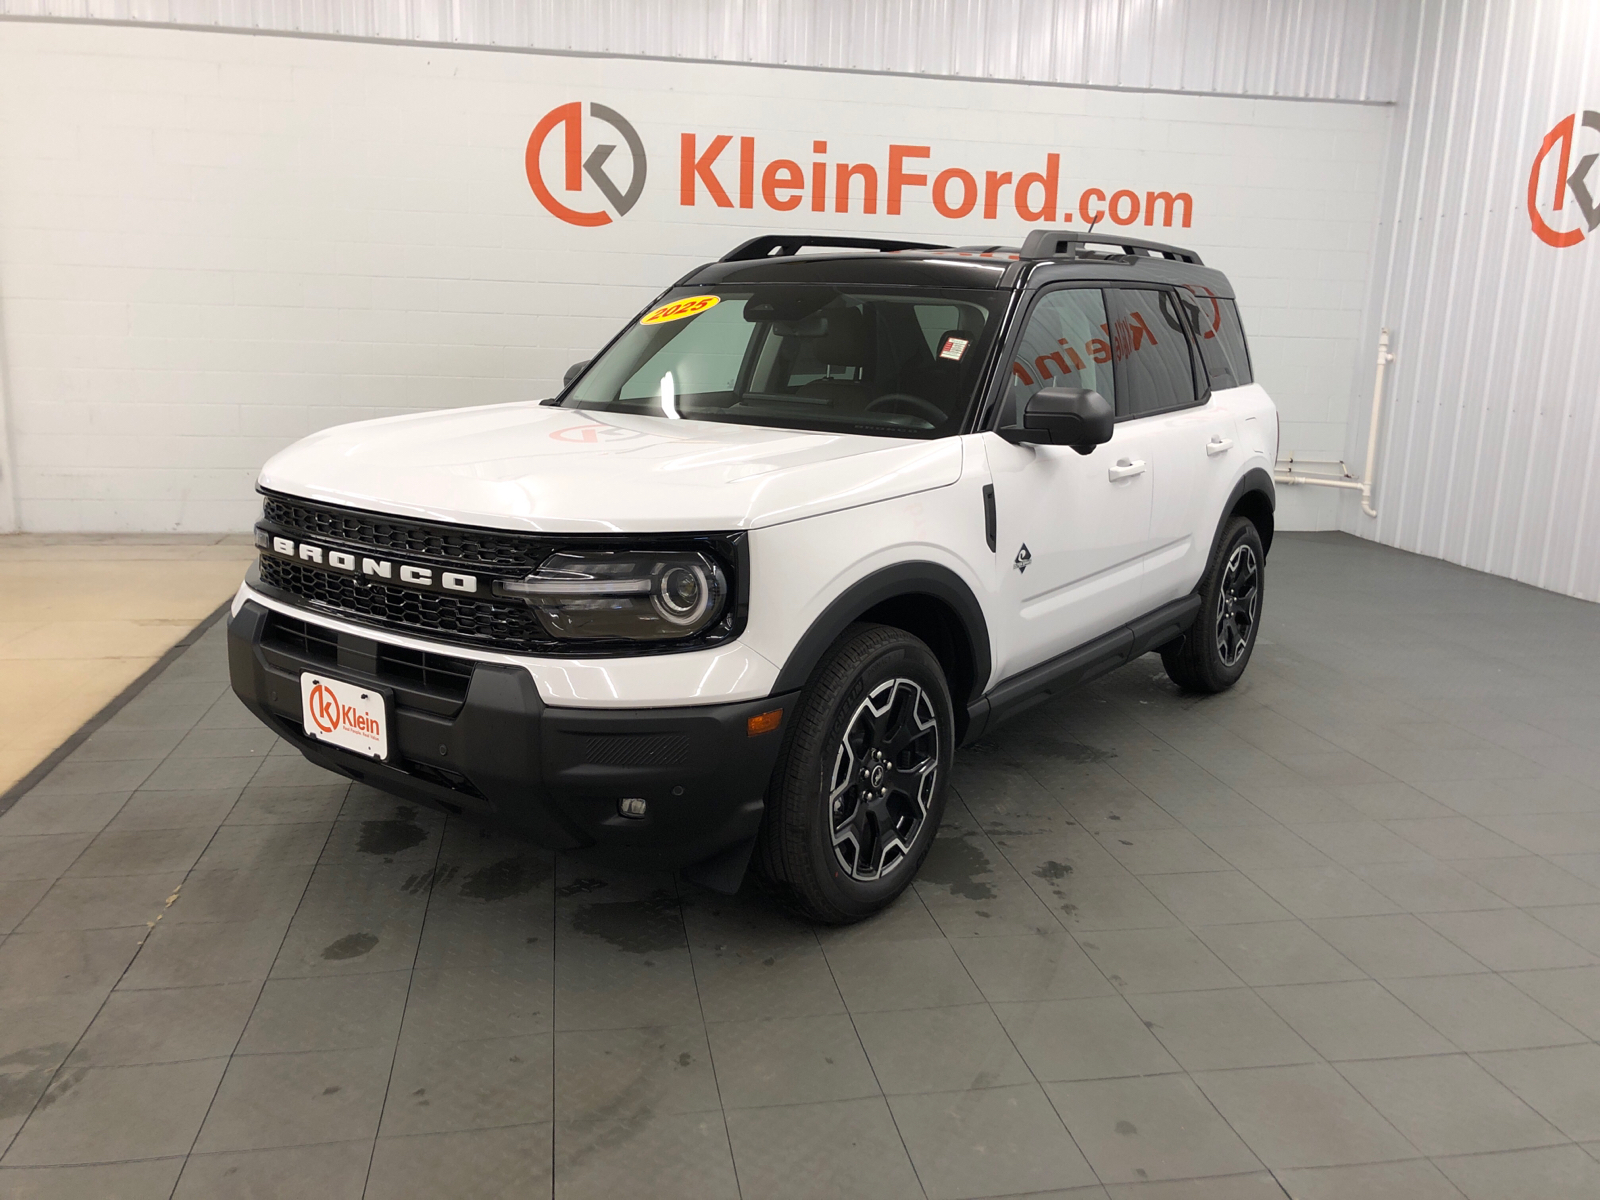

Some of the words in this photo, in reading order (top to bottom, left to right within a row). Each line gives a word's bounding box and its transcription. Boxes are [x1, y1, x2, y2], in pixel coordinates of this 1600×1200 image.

[679, 132, 1193, 229] KleinFord.com
[645, 297, 714, 322] 2025
[273, 536, 477, 593] BRONCO
[342, 704, 380, 736] Klein
